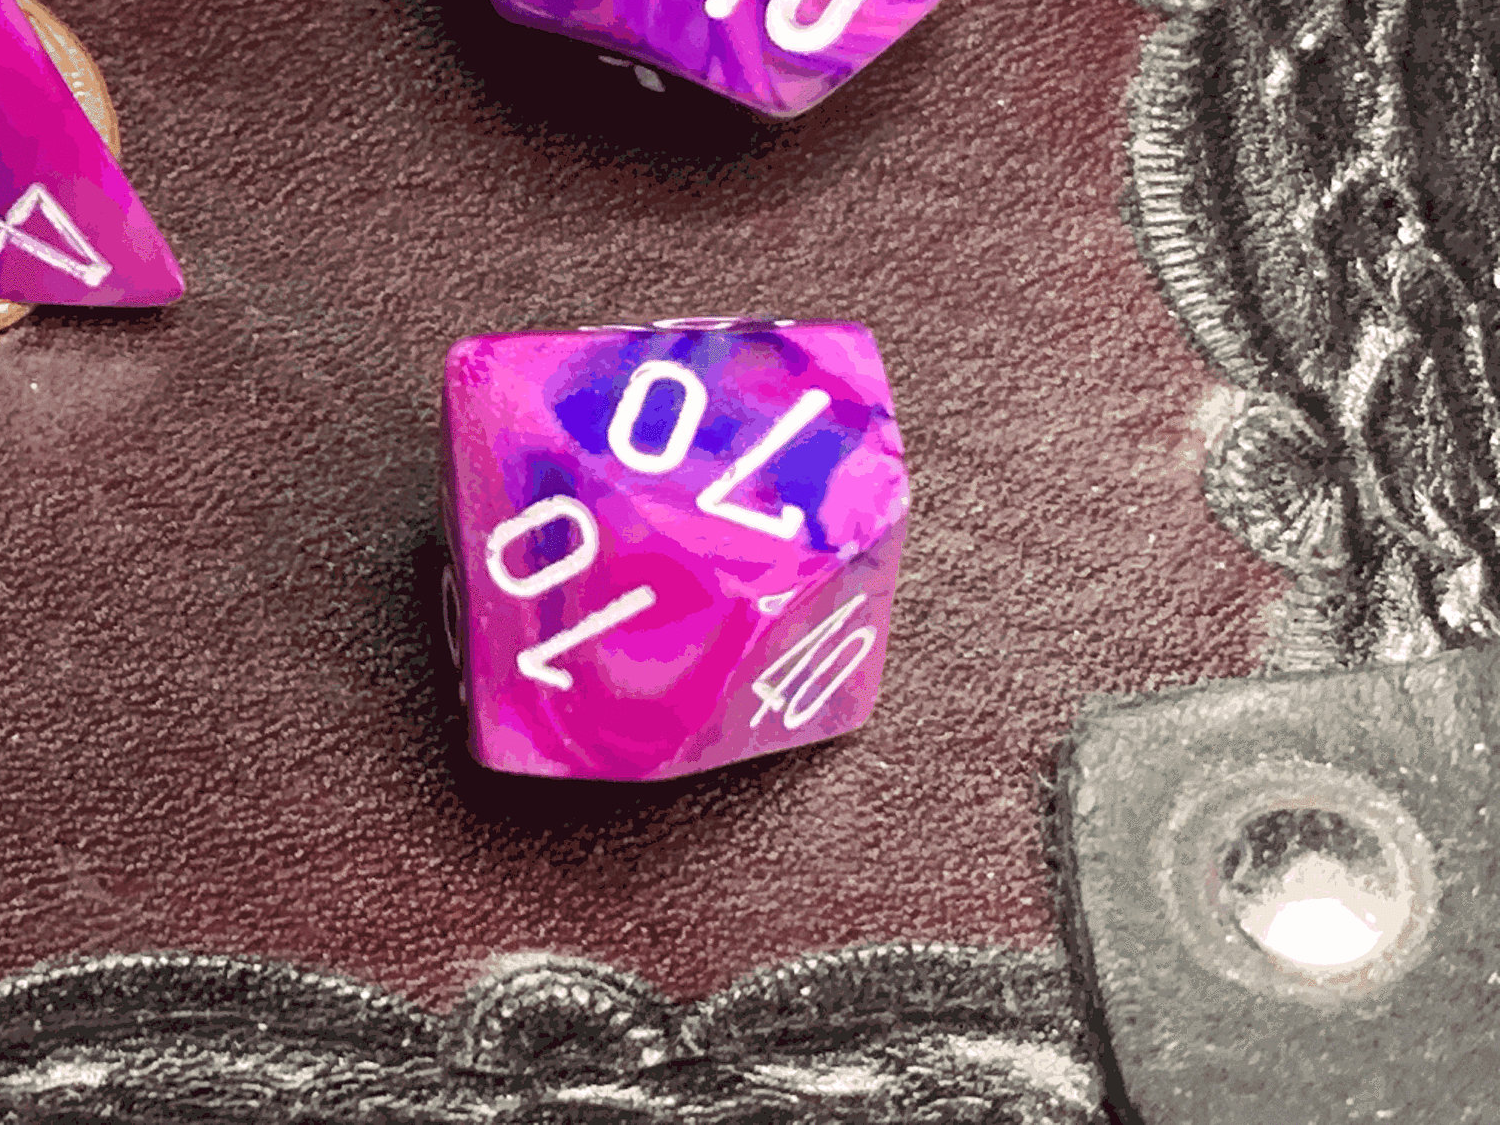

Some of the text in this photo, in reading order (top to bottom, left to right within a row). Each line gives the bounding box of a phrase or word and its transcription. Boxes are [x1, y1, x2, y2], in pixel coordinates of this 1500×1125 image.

[606, 358, 831, 541] 70
[485, 494, 655, 691] 10
[749, 593, 878, 730] 40
